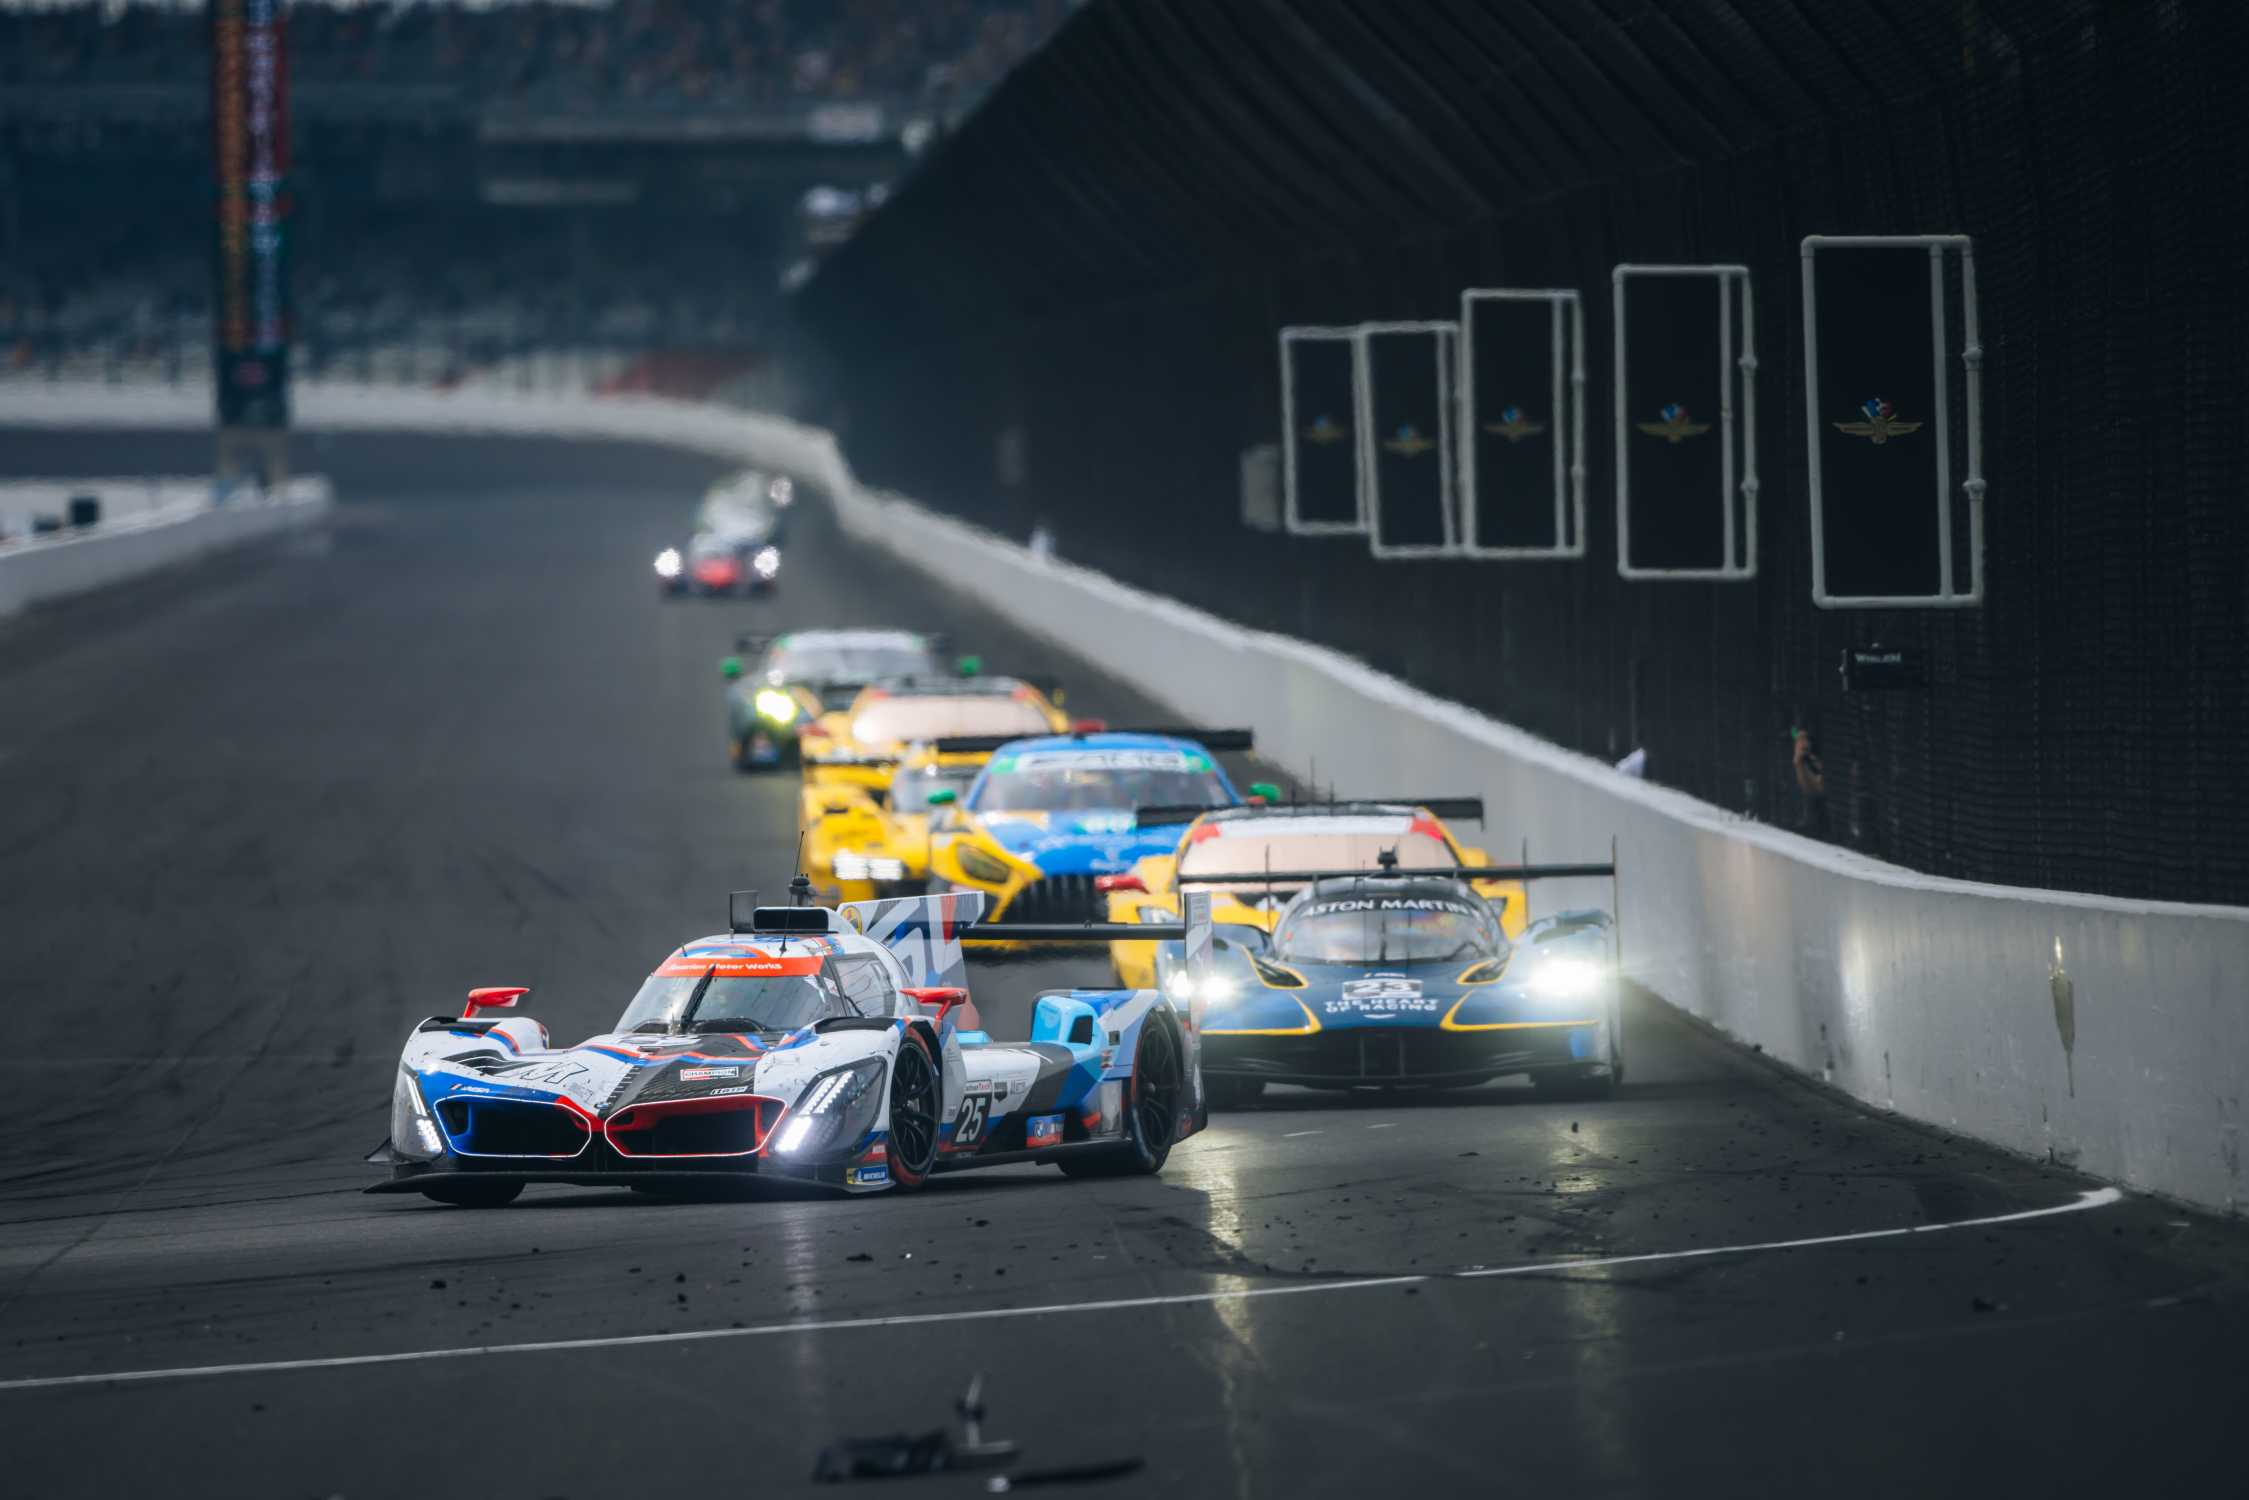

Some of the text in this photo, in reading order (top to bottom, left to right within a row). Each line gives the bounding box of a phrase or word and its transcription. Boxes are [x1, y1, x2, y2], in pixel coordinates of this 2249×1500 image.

[1302, 899, 1468, 916] ASTON MARTIN
[1371, 998, 1440, 1006] HEART
[1360, 1004, 1438, 1012] RACING
[684, 1068, 736, 1078] CHAMPION
[955, 1097, 987, 1143] 25
